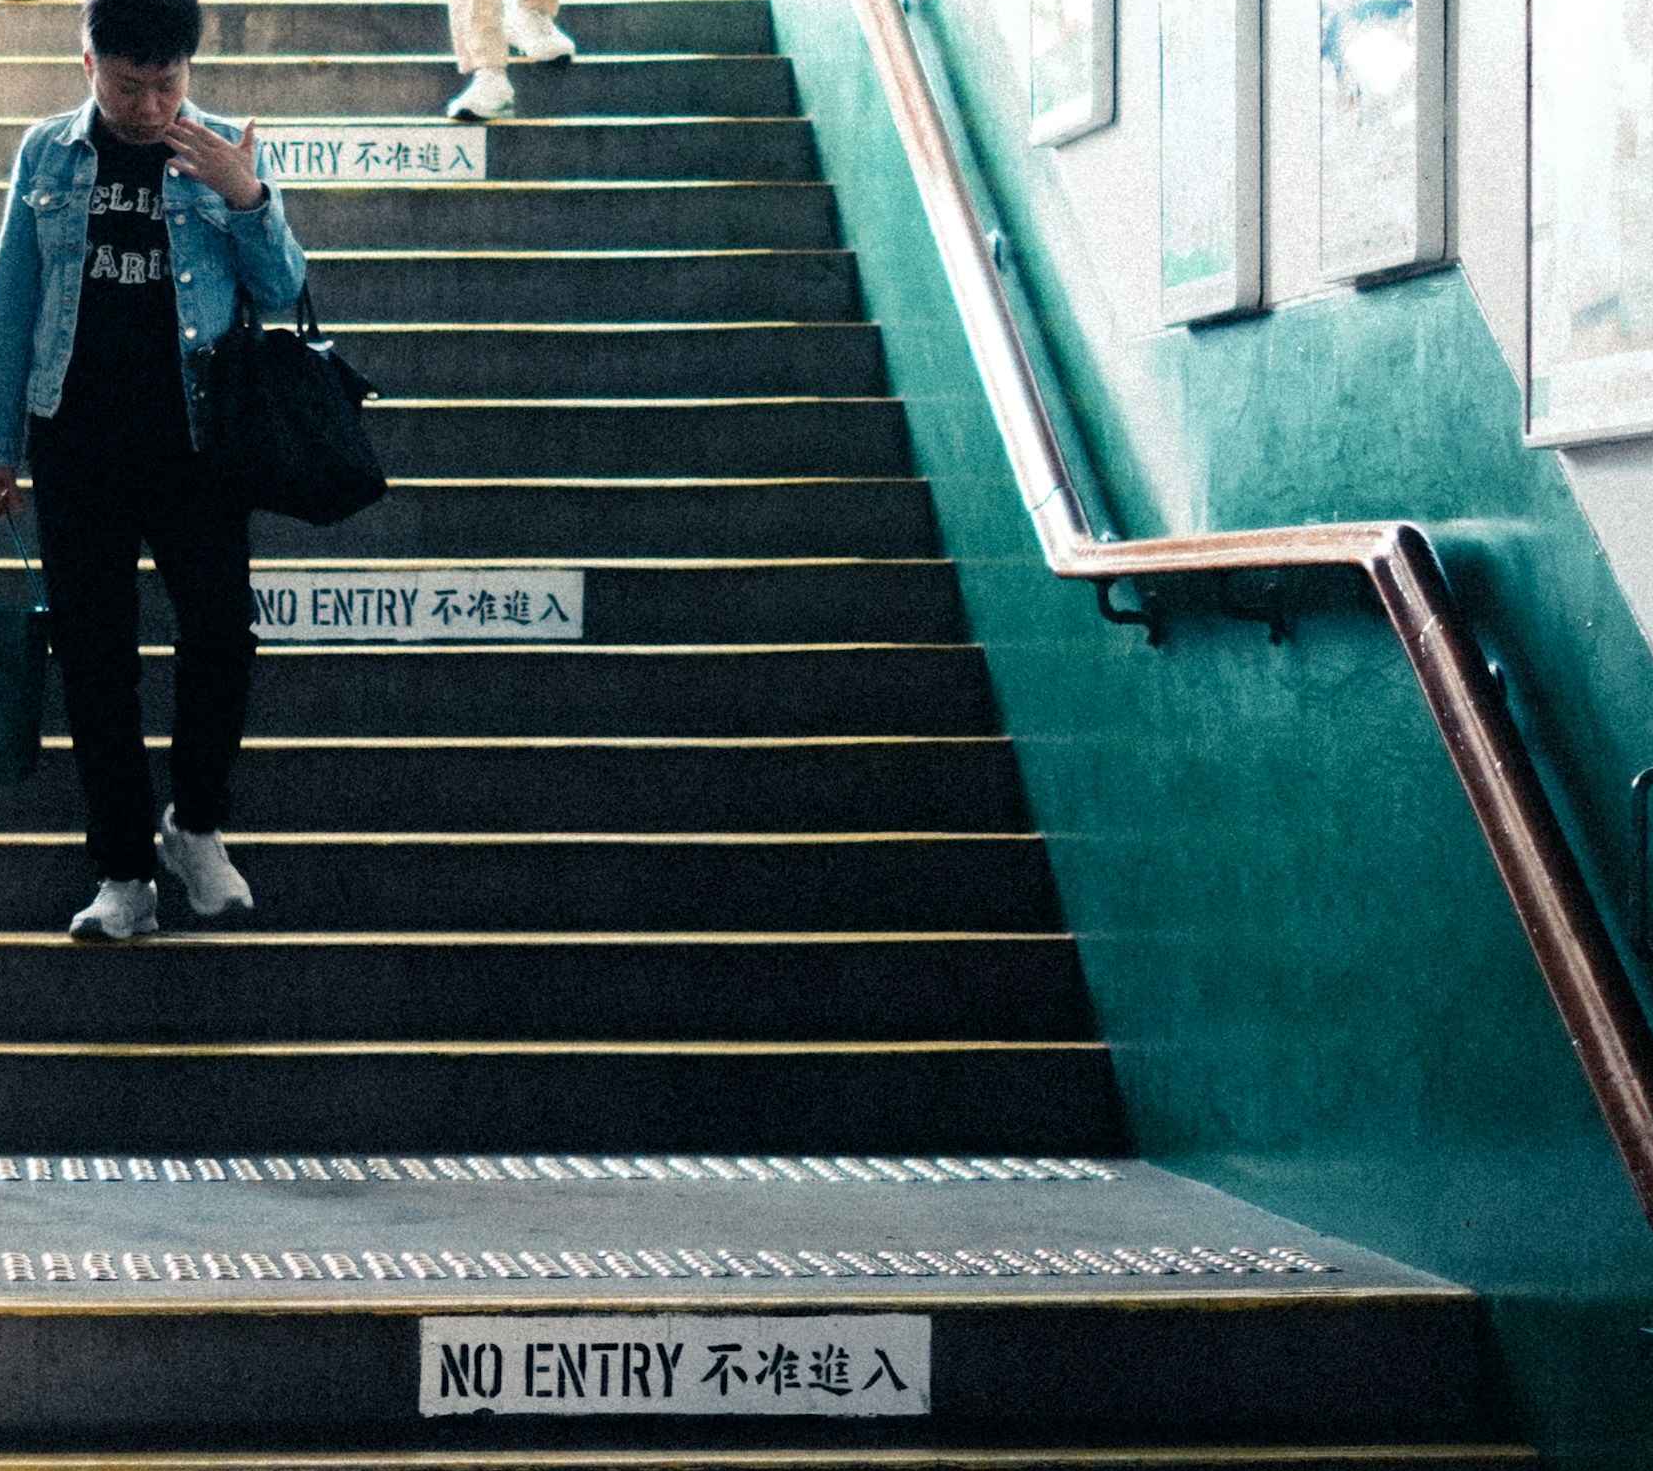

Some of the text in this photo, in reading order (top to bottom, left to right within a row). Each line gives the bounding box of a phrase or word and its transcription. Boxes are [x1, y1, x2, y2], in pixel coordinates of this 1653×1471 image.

[263, 141, 475, 174] NTRY 不准進入
[87, 244, 170, 284] ARI
[255, 588, 570, 627] NO ENTRY 不准進入
[440, 1342, 909, 1398] NO ENTRY 不准進入
